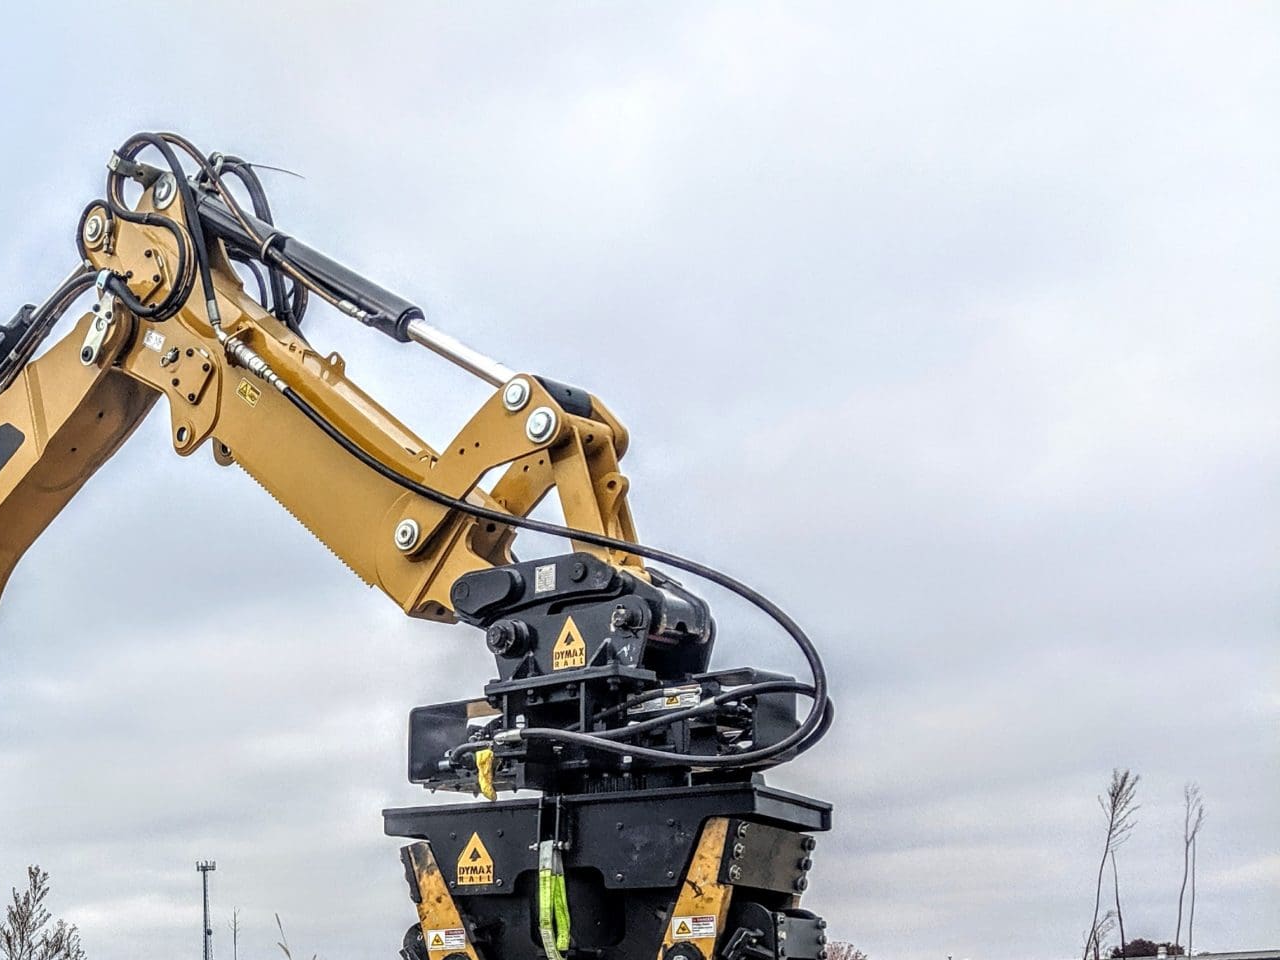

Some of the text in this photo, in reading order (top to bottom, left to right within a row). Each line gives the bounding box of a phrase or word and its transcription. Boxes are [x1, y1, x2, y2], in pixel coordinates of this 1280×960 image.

[554, 647, 584, 660] DYMAX
[554, 657, 584, 667] RAIL
[458, 865, 492, 875] DYMAX
[458, 875, 491, 883] RAIL
